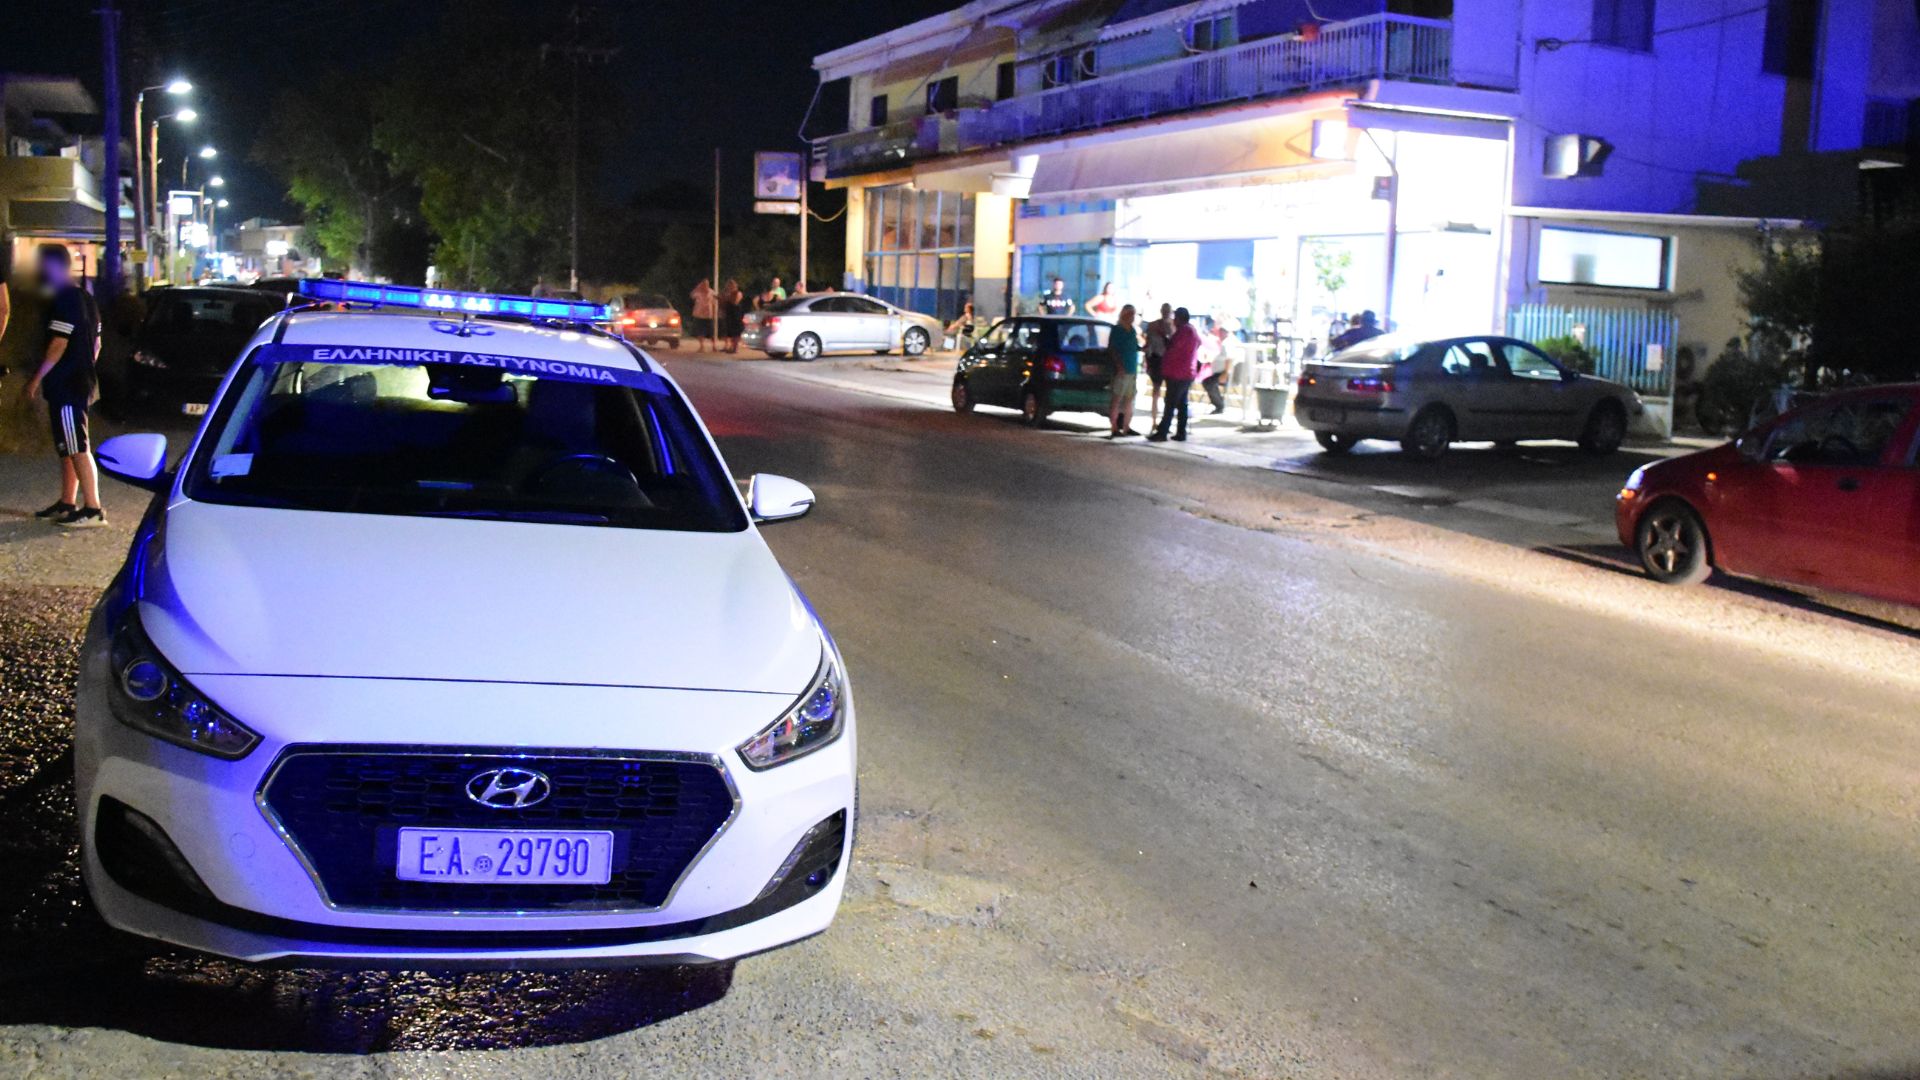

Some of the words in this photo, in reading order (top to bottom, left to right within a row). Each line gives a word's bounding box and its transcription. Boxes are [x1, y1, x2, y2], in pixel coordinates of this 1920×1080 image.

[312, 348, 452, 363] ΕΛΛΗΝΙΚΗ
[459, 353, 618, 383] ΑΣΤΥΝΟΜΙΑ
[496, 837, 590, 877] 29790
